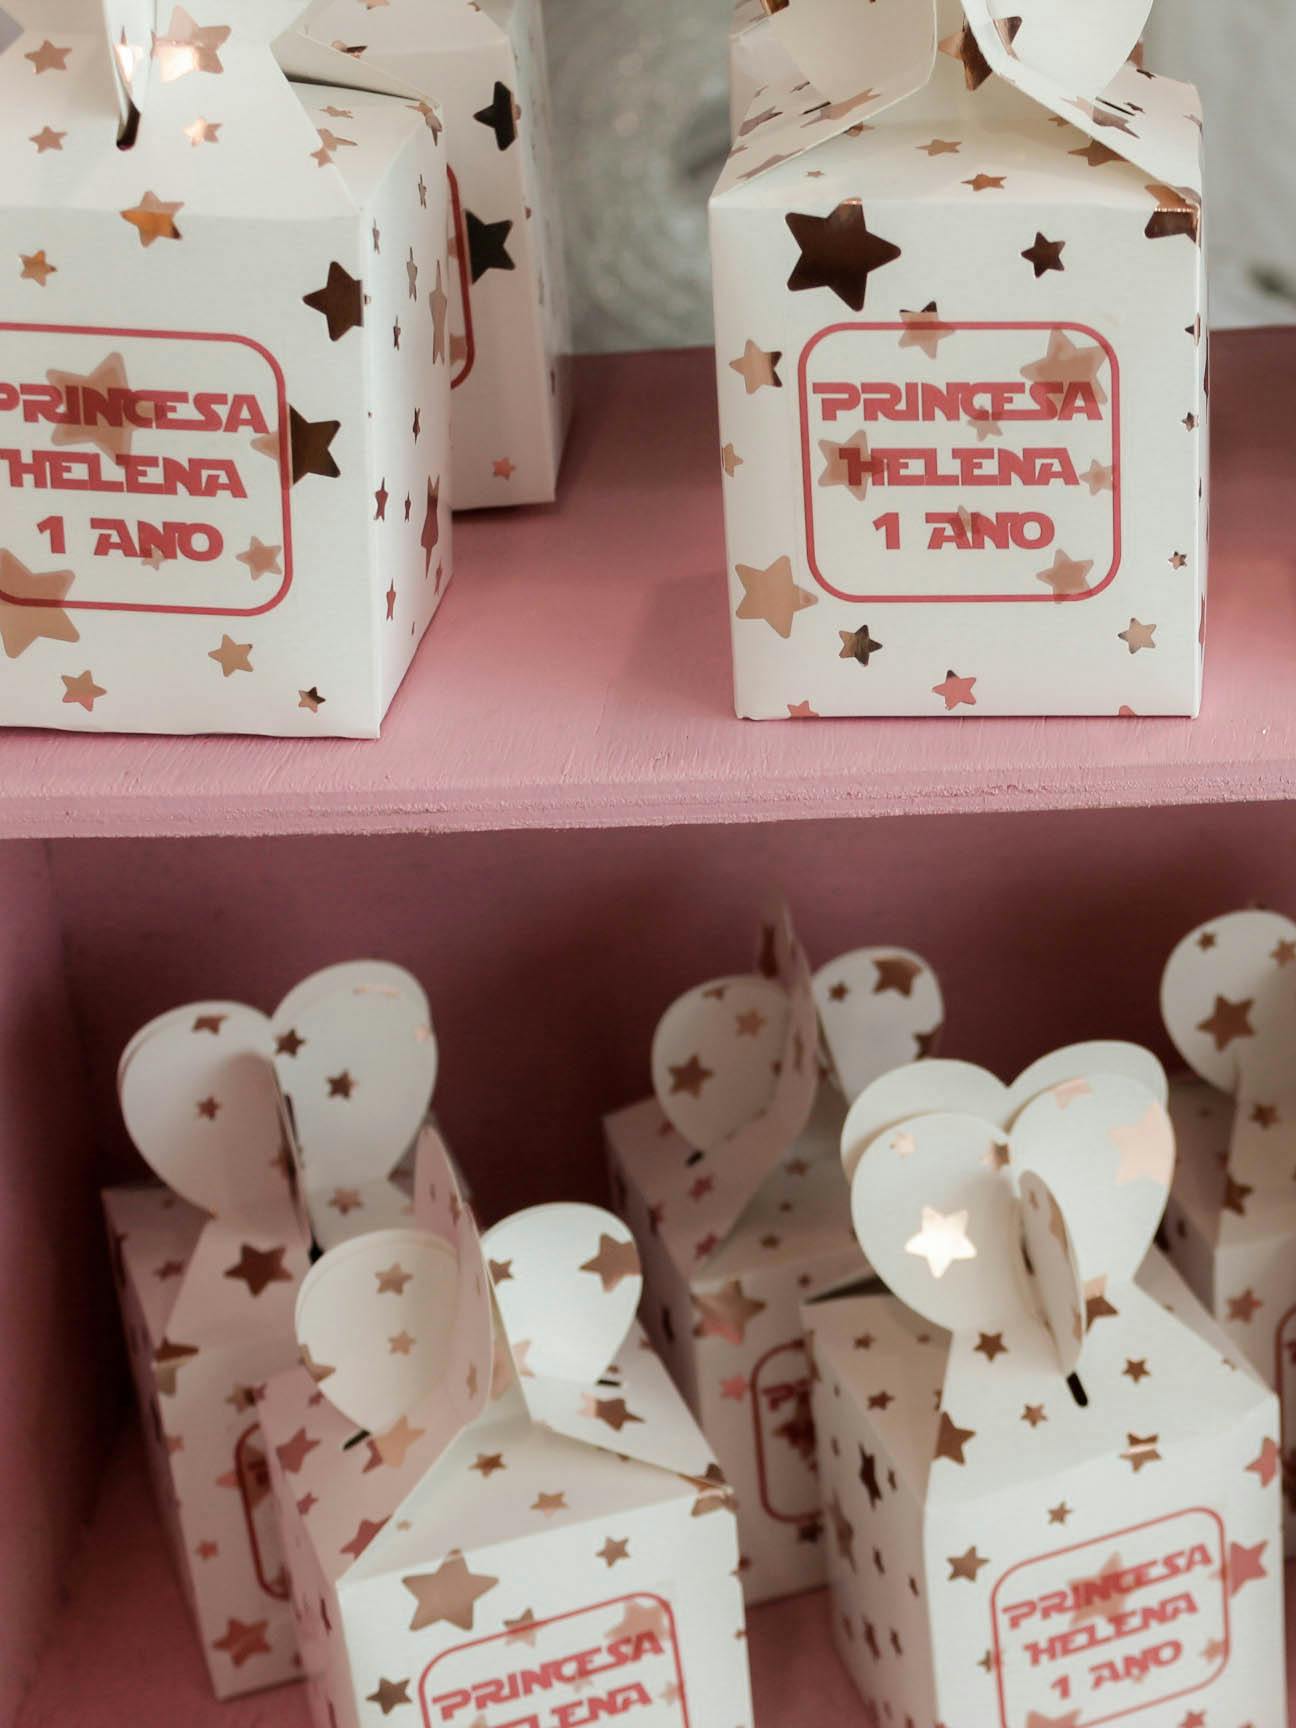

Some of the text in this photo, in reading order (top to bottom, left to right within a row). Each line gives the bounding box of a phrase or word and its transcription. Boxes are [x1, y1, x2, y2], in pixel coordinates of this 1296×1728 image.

[812, 382, 1103, 421] PRINCESA
[0, 448, 248, 499] HELENA
[839, 448, 1080, 486] HELENA
[37, 516, 224, 562] 1 ANO
[872, 512, 1055, 550] 1 ANO
[1000, 1542, 1212, 1631] PRINCESA
[1023, 1592, 1198, 1667] HELENA
[431, 1630, 665, 1722] PRINCESA
[1050, 1639, 1183, 1700] 1 ANO
